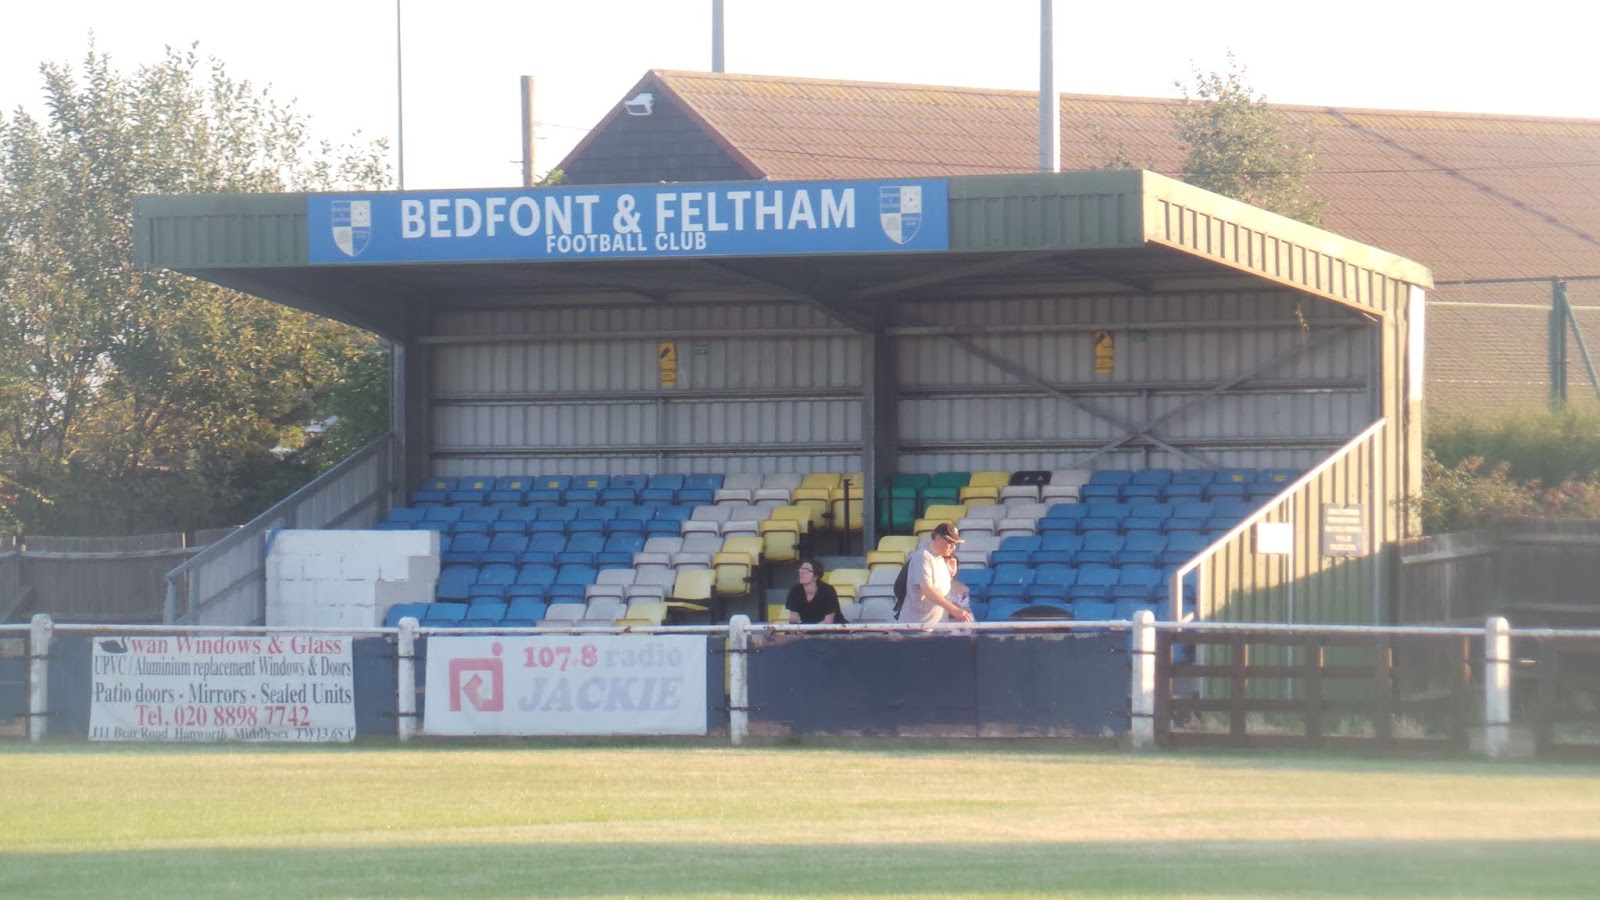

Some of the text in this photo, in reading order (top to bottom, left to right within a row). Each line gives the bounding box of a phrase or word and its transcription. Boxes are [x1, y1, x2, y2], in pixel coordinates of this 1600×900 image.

[401, 189, 855, 238] BEDFONT & FELTHAM
[546, 231, 707, 253] FOOTBALL CLUB
[177, 636, 261, 654] Windows
[267, 636, 284, 654] &
[291, 636, 341, 654] Glass
[606, 643, 683, 668] radio
[134, 656, 190, 675] Aluminium
[194, 657, 255, 681] replacement
[259, 656, 305, 676] Windows
[308, 656, 317, 675] &
[321, 656, 351, 676] Doors
[95, 682, 131, 702] Patio
[136, 683, 175, 702] doors
[189, 683, 246, 704] Mirrors
[261, 683, 306, 703] Sealed
[313, 683, 352, 703] Units
[518, 676, 684, 712] JACKIE
[135, 705, 310, 726] Tel. 020 8898 7742
[141, 728, 168, 738] Road
[175, 728, 226, 740] Hanworth
